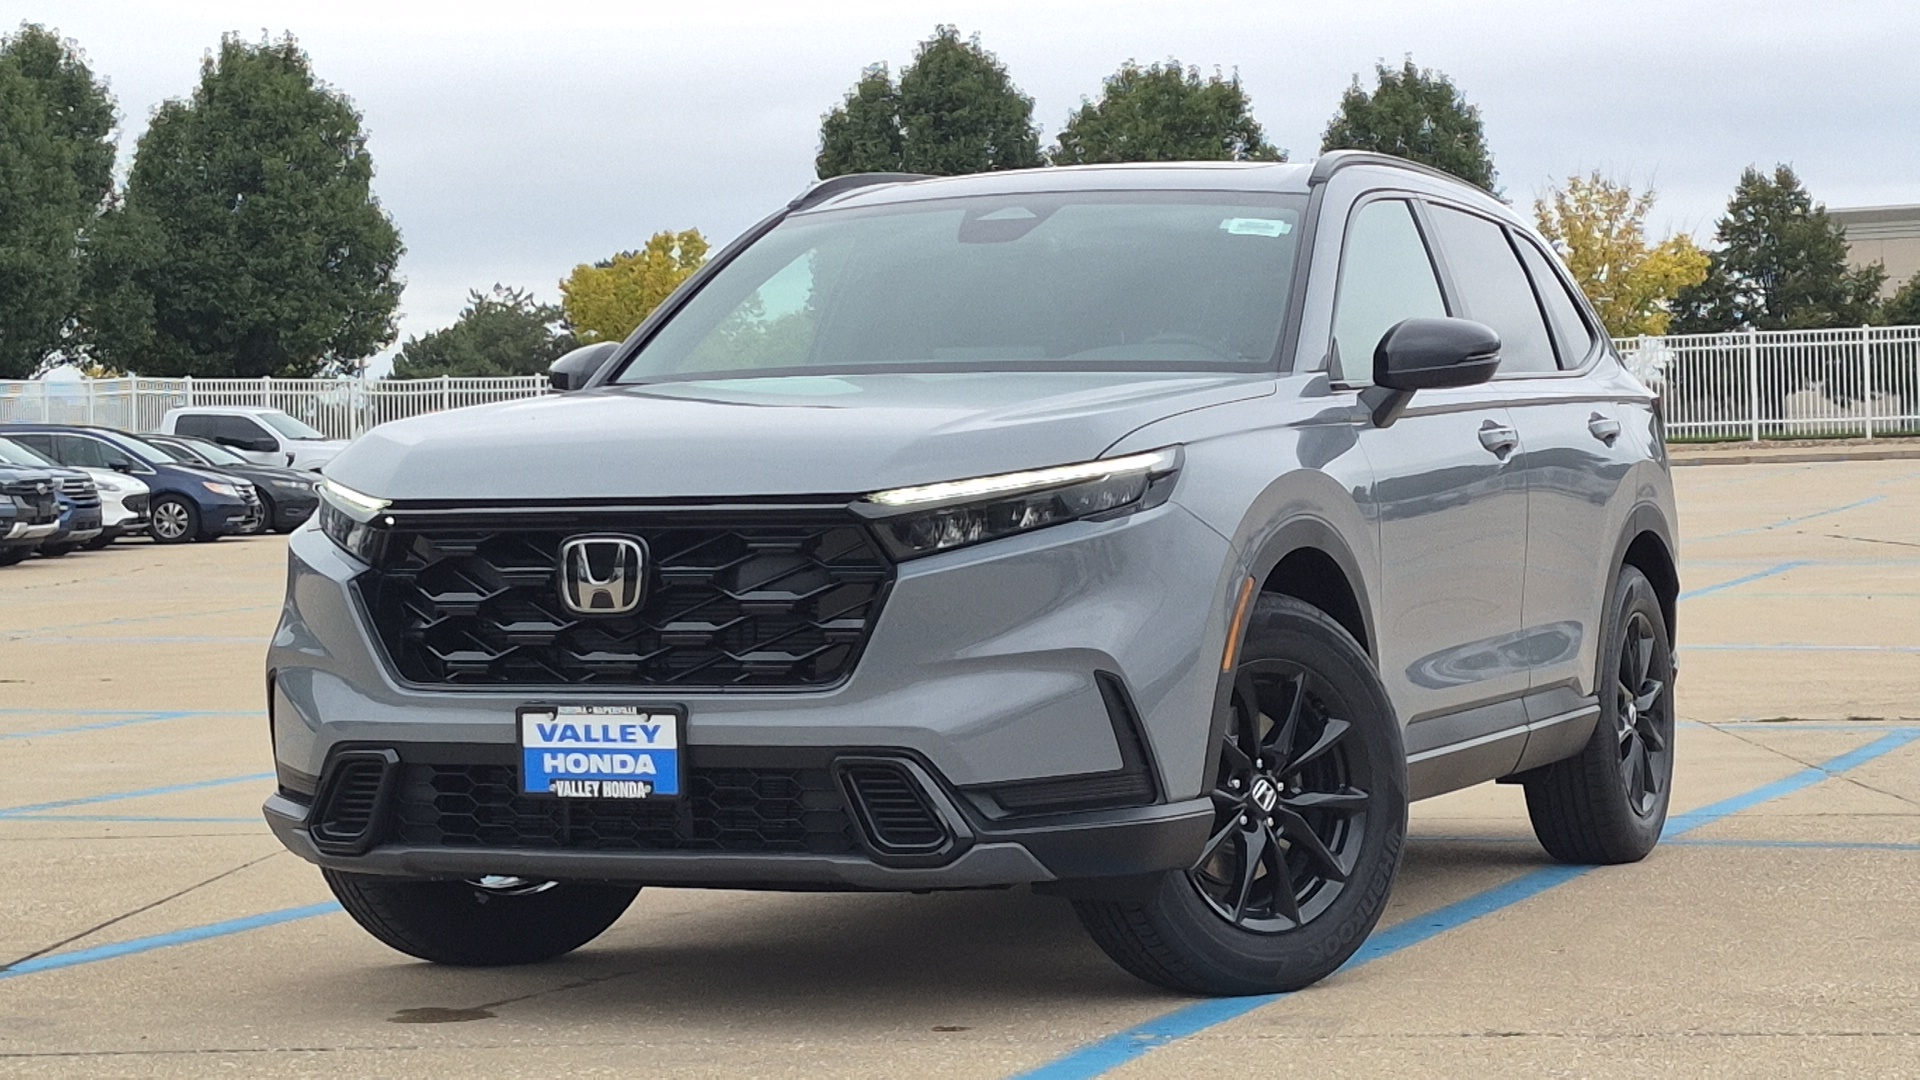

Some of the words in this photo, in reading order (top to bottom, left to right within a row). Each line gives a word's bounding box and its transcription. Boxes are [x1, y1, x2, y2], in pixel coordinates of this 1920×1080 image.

[536, 723, 662, 744] VALLEY
[543, 752, 657, 775] HONDA
[556, 780, 600, 798] VALLEY
[602, 781, 646, 798] HONDA
